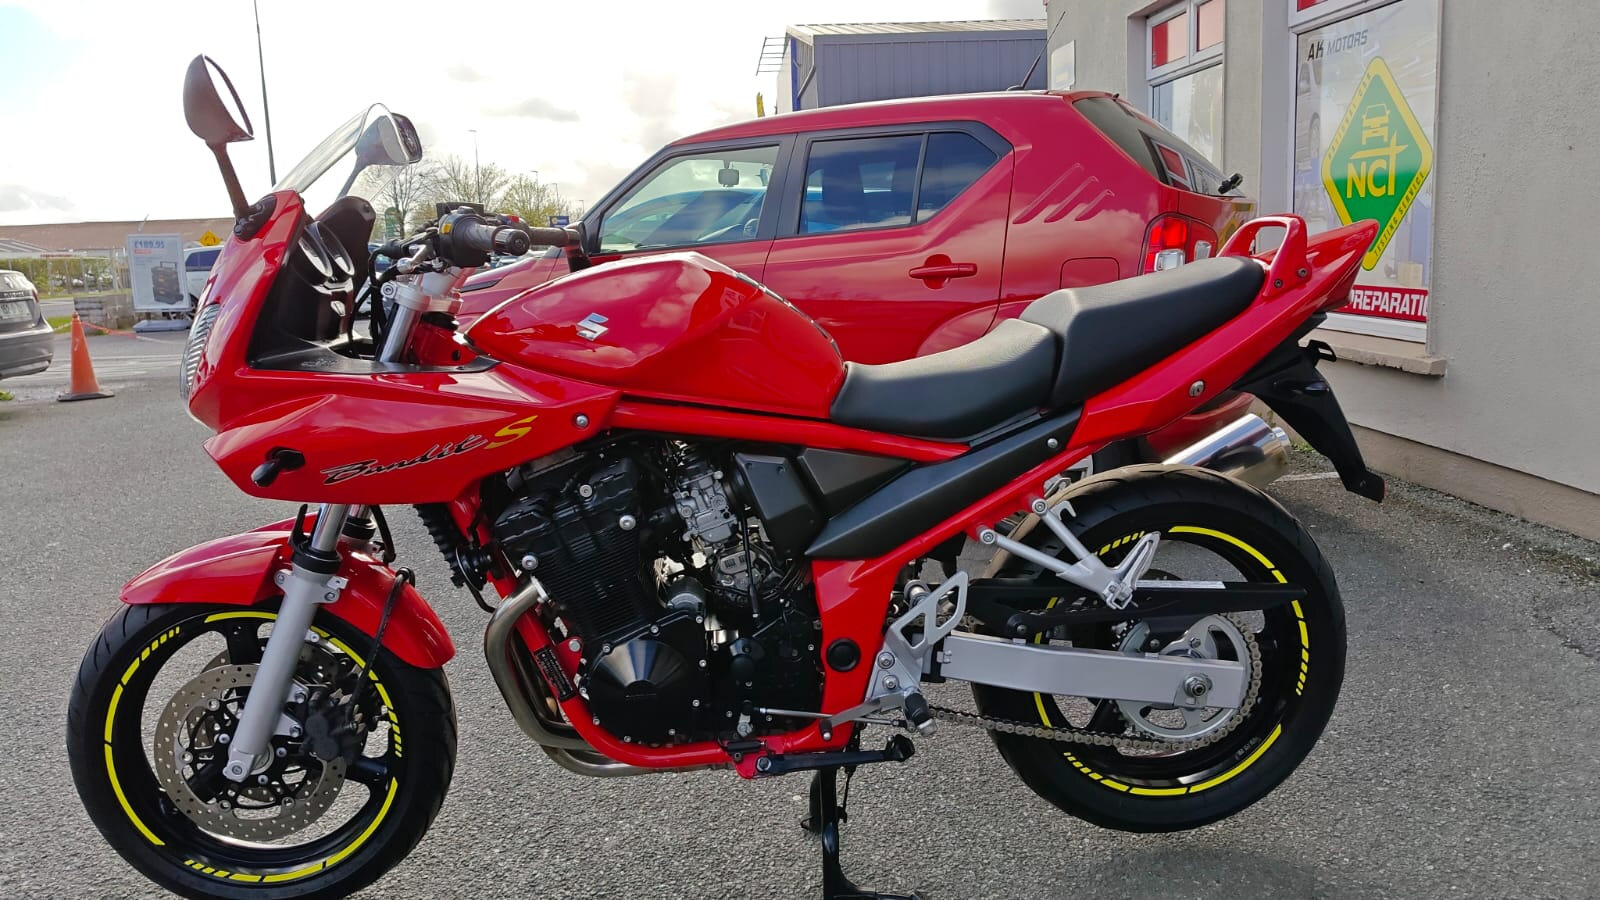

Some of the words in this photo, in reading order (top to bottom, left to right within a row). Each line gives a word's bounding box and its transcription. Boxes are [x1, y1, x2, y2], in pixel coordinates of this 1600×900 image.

[1307, 40, 1324, 61] AK
[1327, 29, 1369, 55] MOTORS
[1346, 146, 1399, 198] NCT
[1373, 215, 1399, 257] TESTING
[320, 434, 488, 485] Bandit
[484, 415, 538, 449] S
